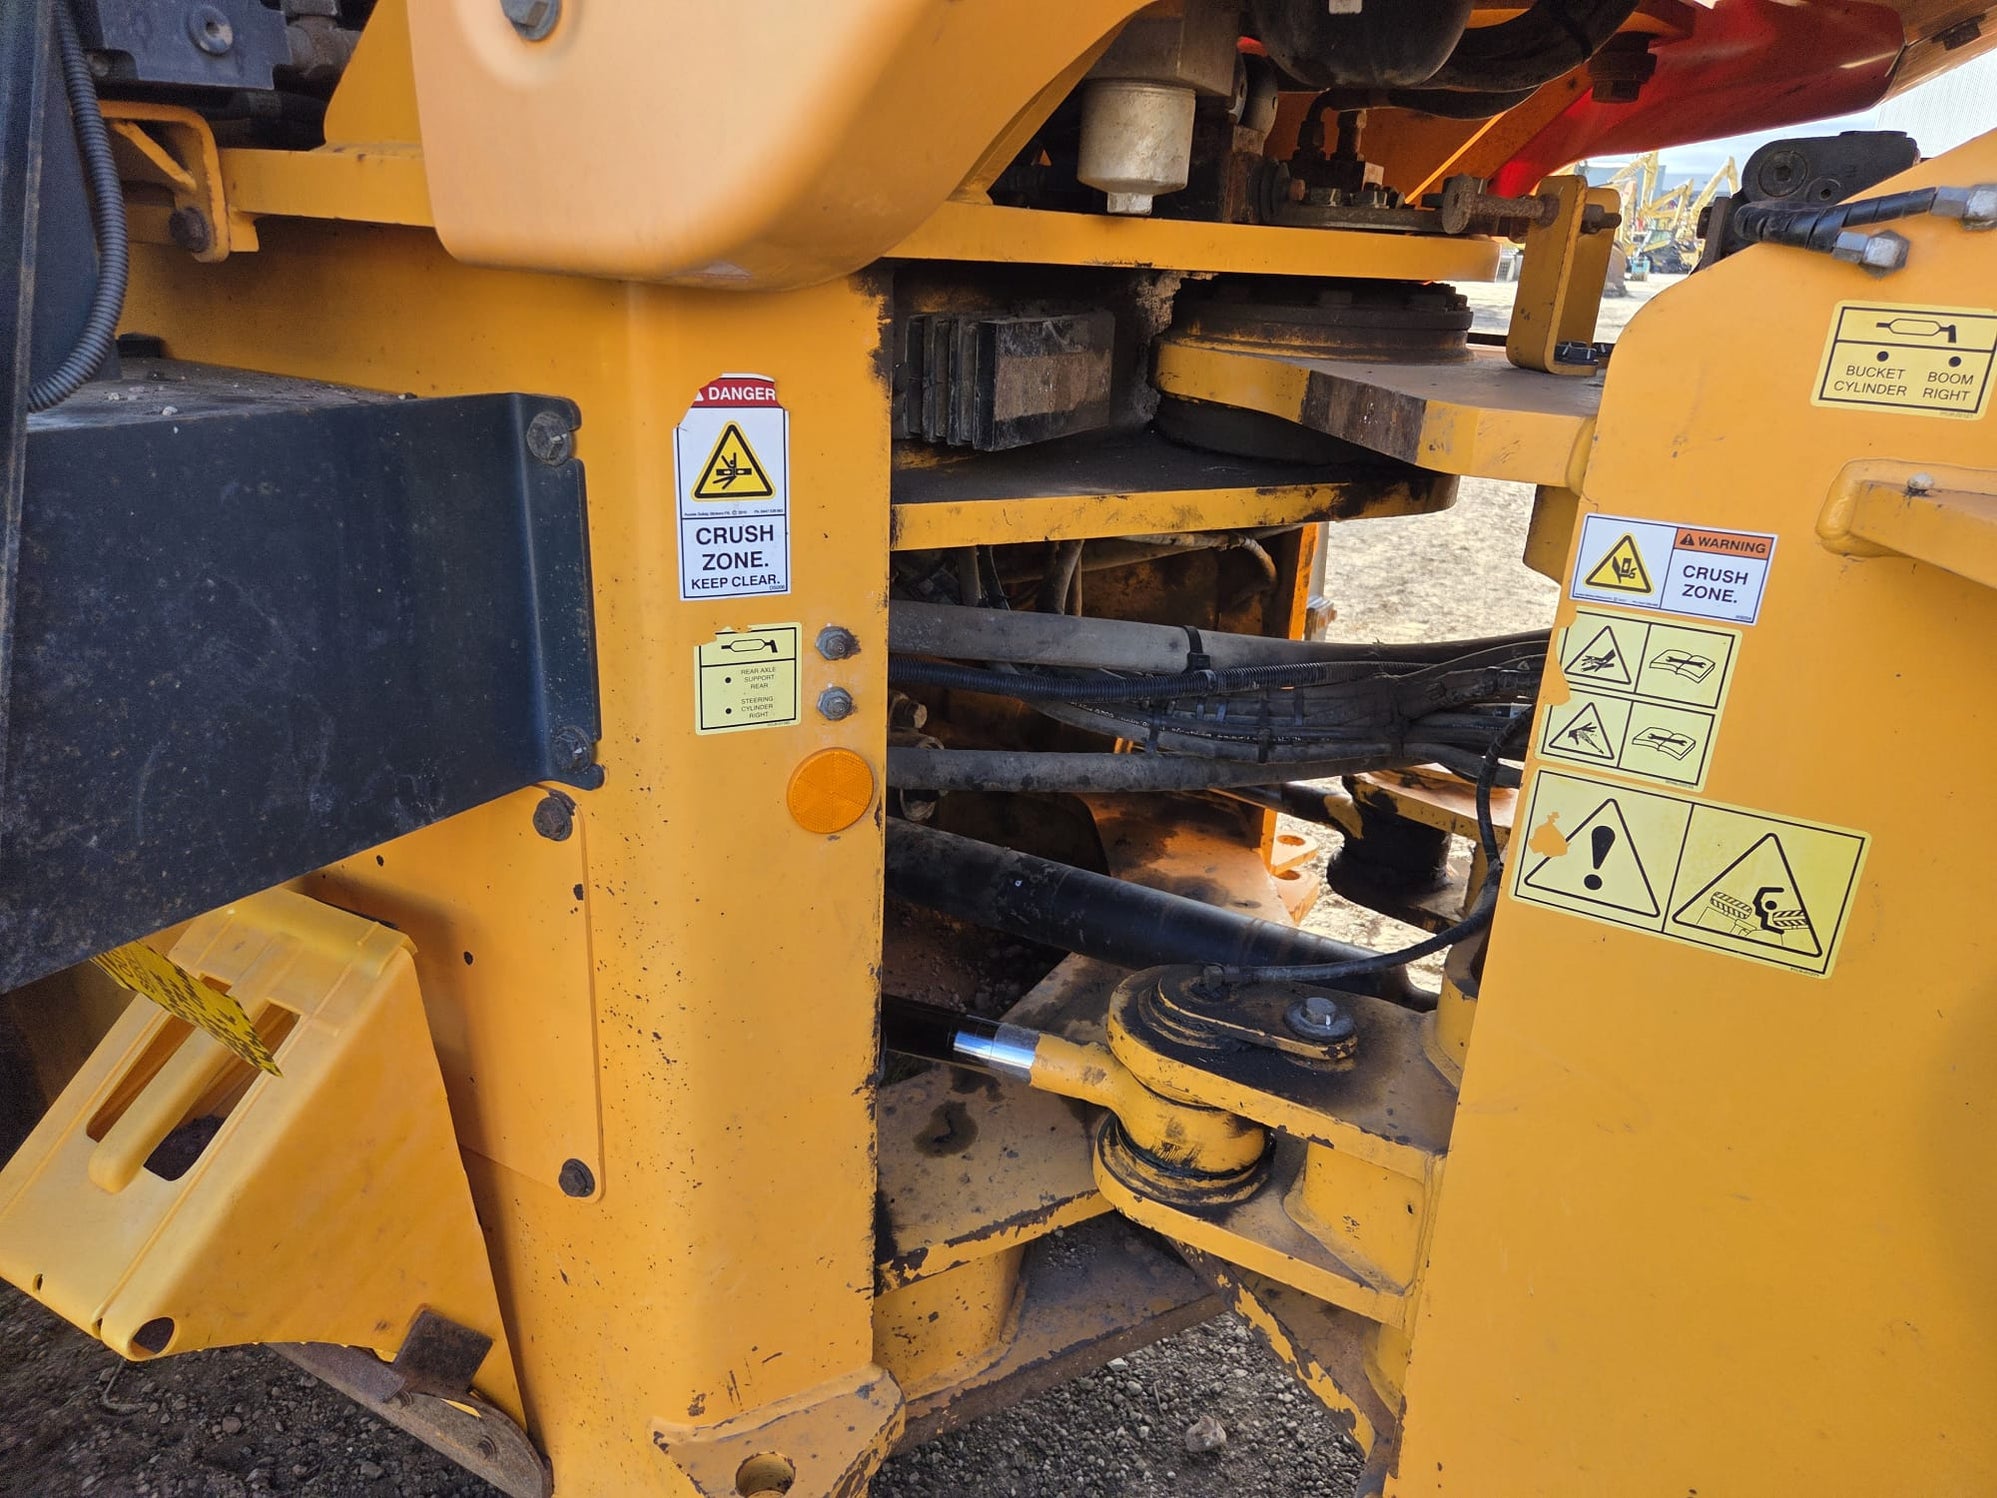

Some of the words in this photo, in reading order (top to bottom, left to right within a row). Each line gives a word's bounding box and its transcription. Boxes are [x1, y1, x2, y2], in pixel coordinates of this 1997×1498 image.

[1846, 365, 1906, 380] BUCKET
[1927, 371, 1974, 385] BOOM
[708, 386, 776, 401] DANGER
[1834, 380, 1907, 396] CYLINDER
[1922, 388, 1971, 402] RIGHT
[696, 524, 774, 545] CRUSH
[1698, 536, 1766, 554] WARNING
[702, 551, 769, 571] ZONE.
[691, 577, 728, 590] KEEP
[731, 574, 780, 588] CLEAR.
[1682, 565, 1749, 585] CRUSH
[1681, 584, 1738, 603] ZONE.
[744, 674, 774, 682] SUPPORT
[741, 696, 773, 704] STEERING
